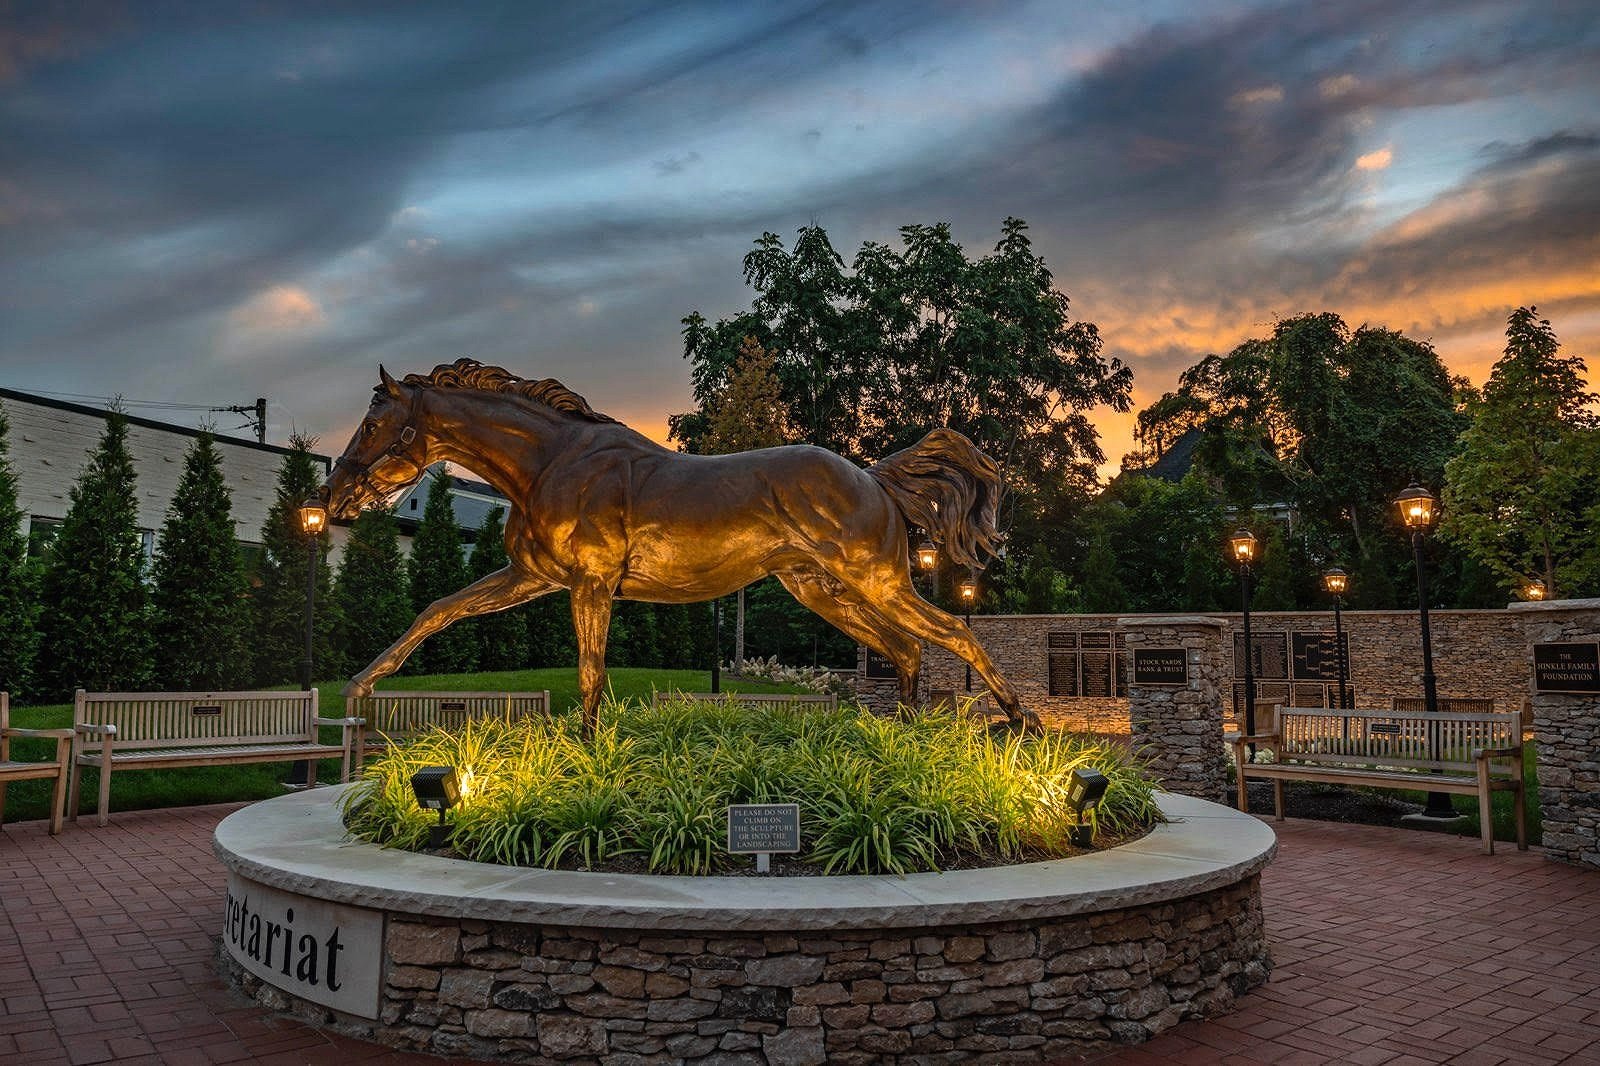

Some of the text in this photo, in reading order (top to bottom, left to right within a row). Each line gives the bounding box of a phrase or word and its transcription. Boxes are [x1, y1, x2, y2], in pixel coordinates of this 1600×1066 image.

[1568, 662, 1596, 670] FAMILY
[1542, 673, 1593, 681] FOUNDATION
[735, 808, 792, 817] PLEASE DO NOT
[735, 824, 793, 833] THE SCULPTURE
[773, 832, 786, 840] THE
[737, 840, 792, 848] LANDSCAPING
[225, 893, 344, 992] retariat
